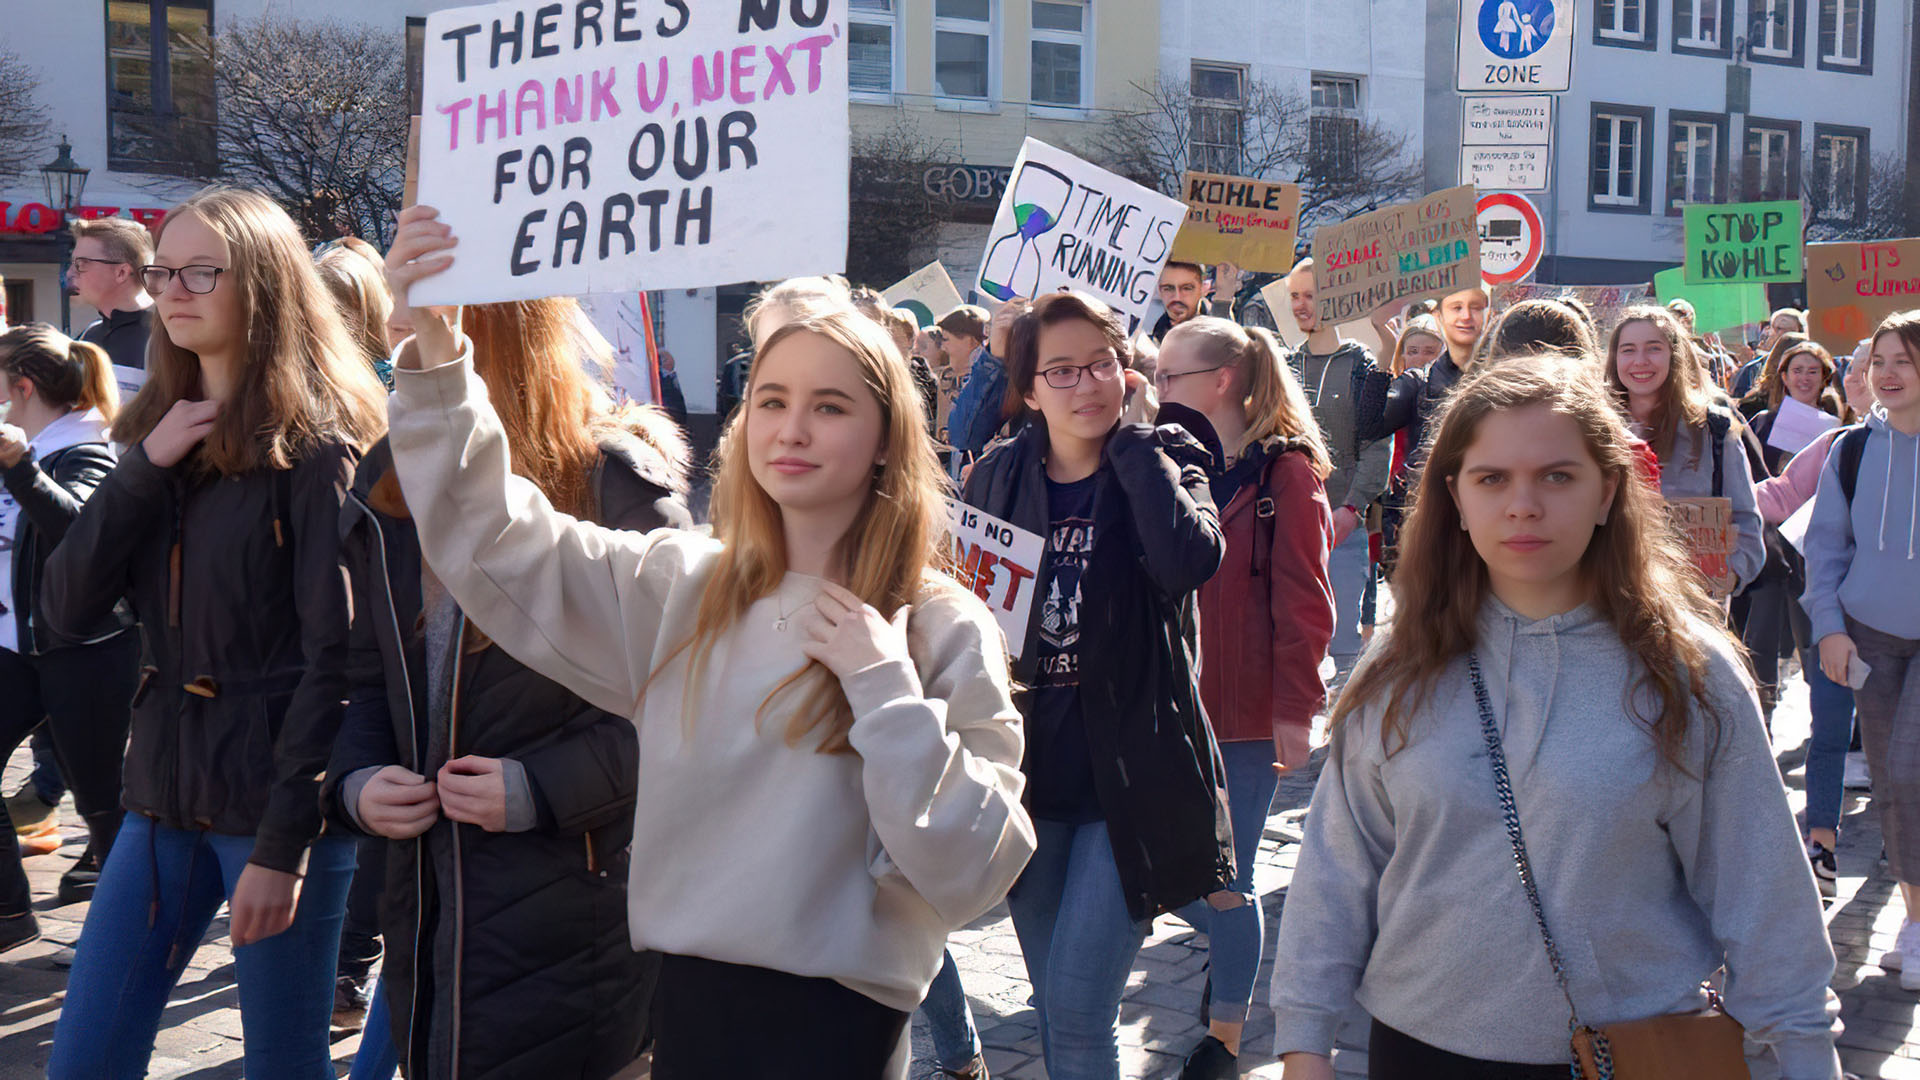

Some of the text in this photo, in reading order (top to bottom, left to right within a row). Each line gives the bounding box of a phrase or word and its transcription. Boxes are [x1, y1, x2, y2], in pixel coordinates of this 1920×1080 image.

[738, 0, 829, 33] NO
[1485, 64, 1542, 84] ZONE
[436, 67, 621, 150] THANK
[493, 111, 758, 203] FOR OUR
[1189, 180, 1282, 211] KOHLE
[510, 186, 712, 276] EARTH
[1078, 184, 1173, 264] TIME IS
[1705, 211, 1783, 244] STOP
[1051, 233, 1155, 305] RUNNING
[1701, 244, 1791, 279] KOHLE
[961, 510, 977, 528] IS
[985, 521, 1014, 548] NO
